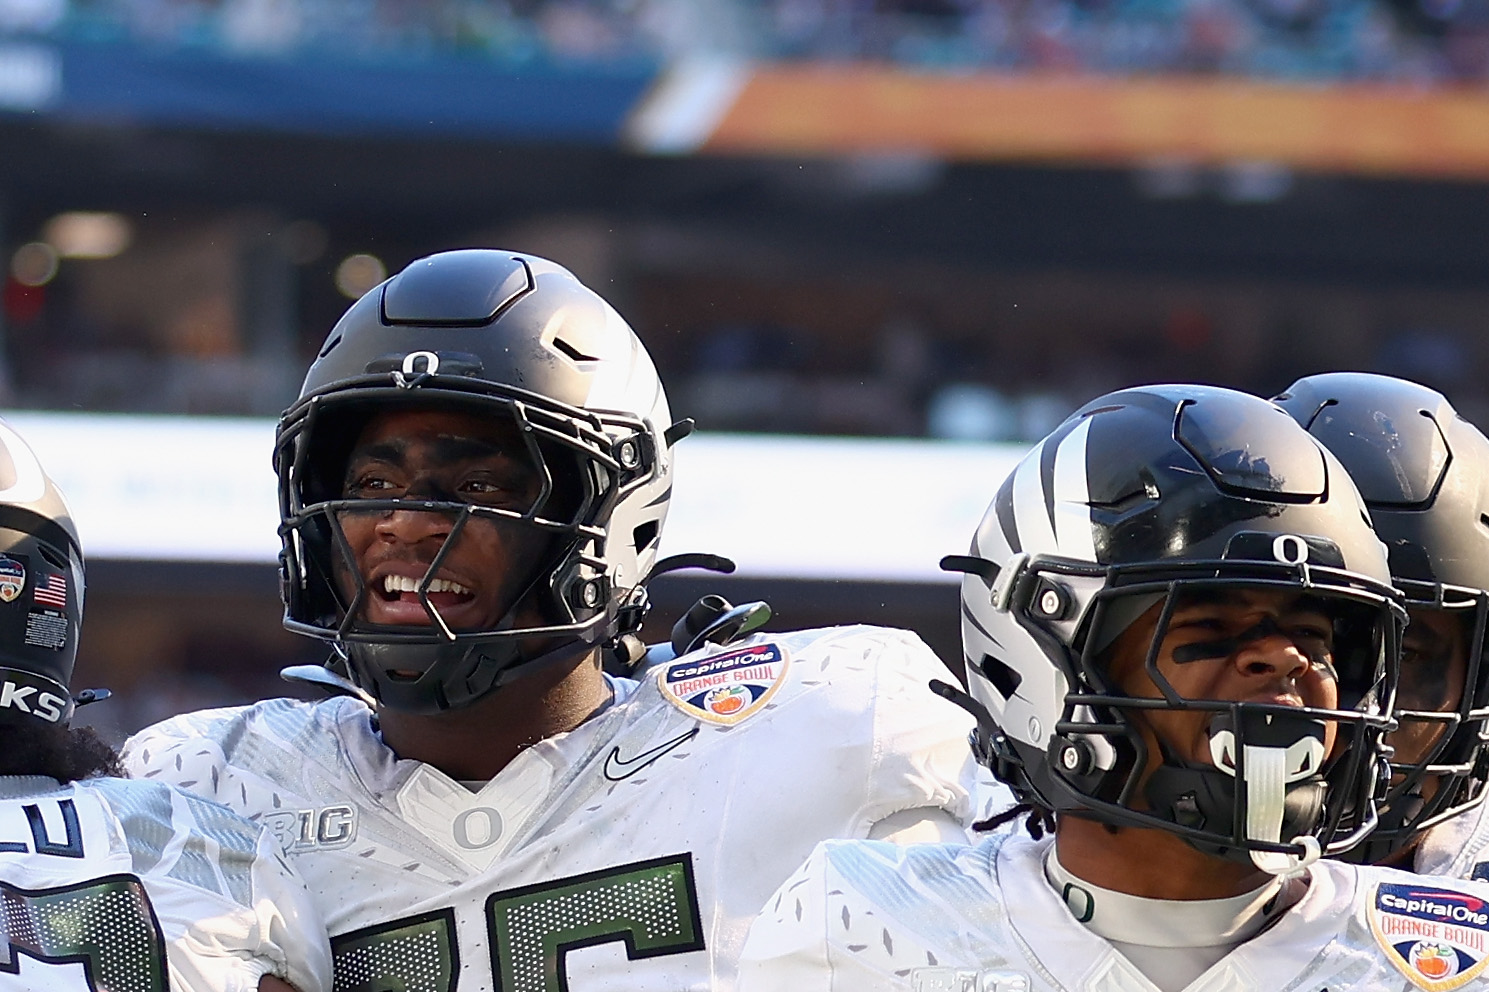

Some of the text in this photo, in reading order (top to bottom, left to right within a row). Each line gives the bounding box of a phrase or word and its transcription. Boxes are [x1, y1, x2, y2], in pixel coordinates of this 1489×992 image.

[672, 665, 776, 697] ORANGE BOWL
[1382, 915, 1488, 954] ORANGE BOWL
